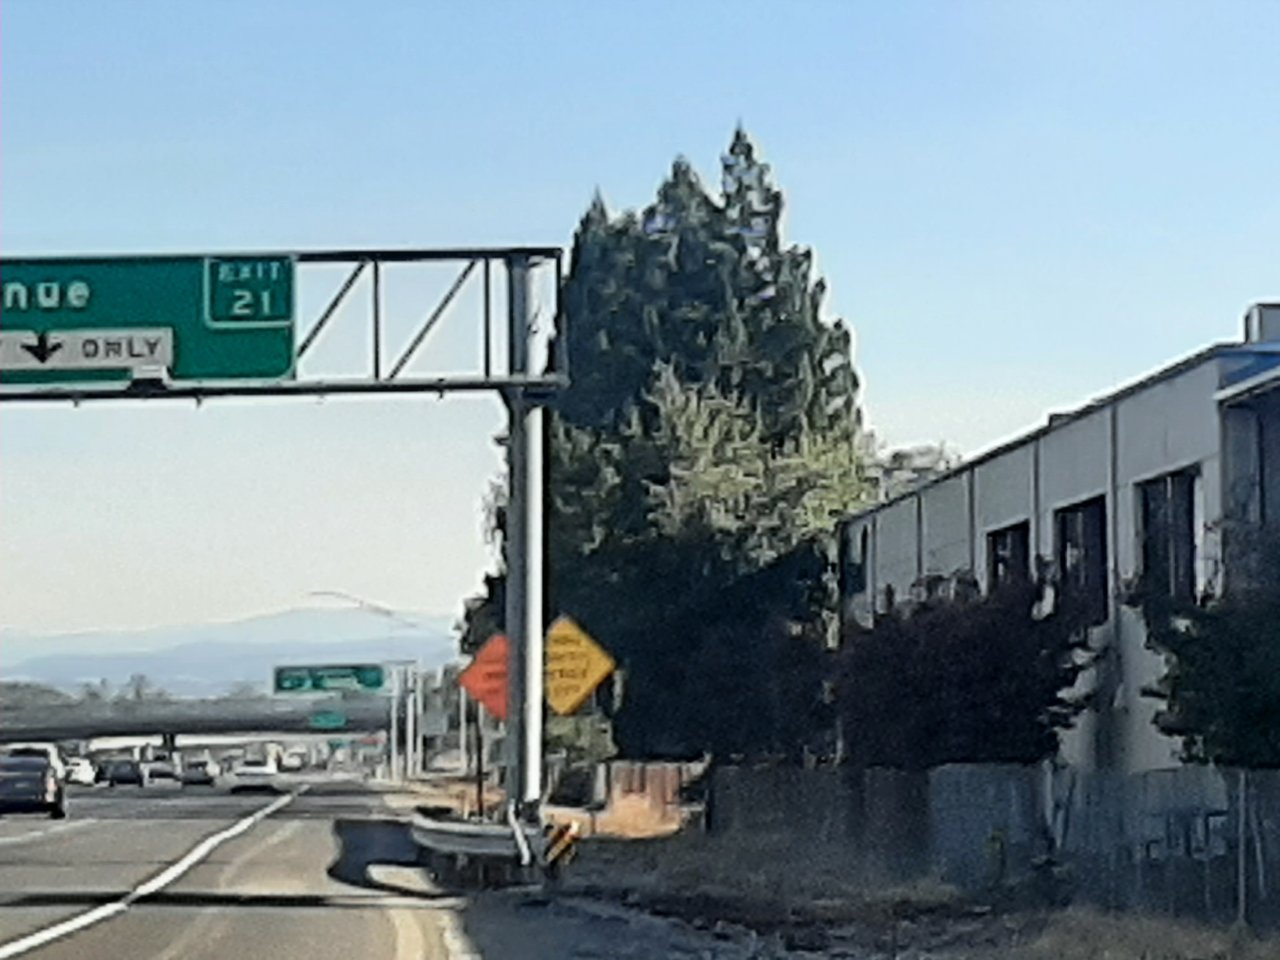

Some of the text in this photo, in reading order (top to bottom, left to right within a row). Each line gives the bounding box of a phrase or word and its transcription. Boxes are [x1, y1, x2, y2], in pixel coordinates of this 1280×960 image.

[219, 262, 281, 281] EXIT
[4, 281, 91, 309] nue
[232, 290, 271, 315] 21
